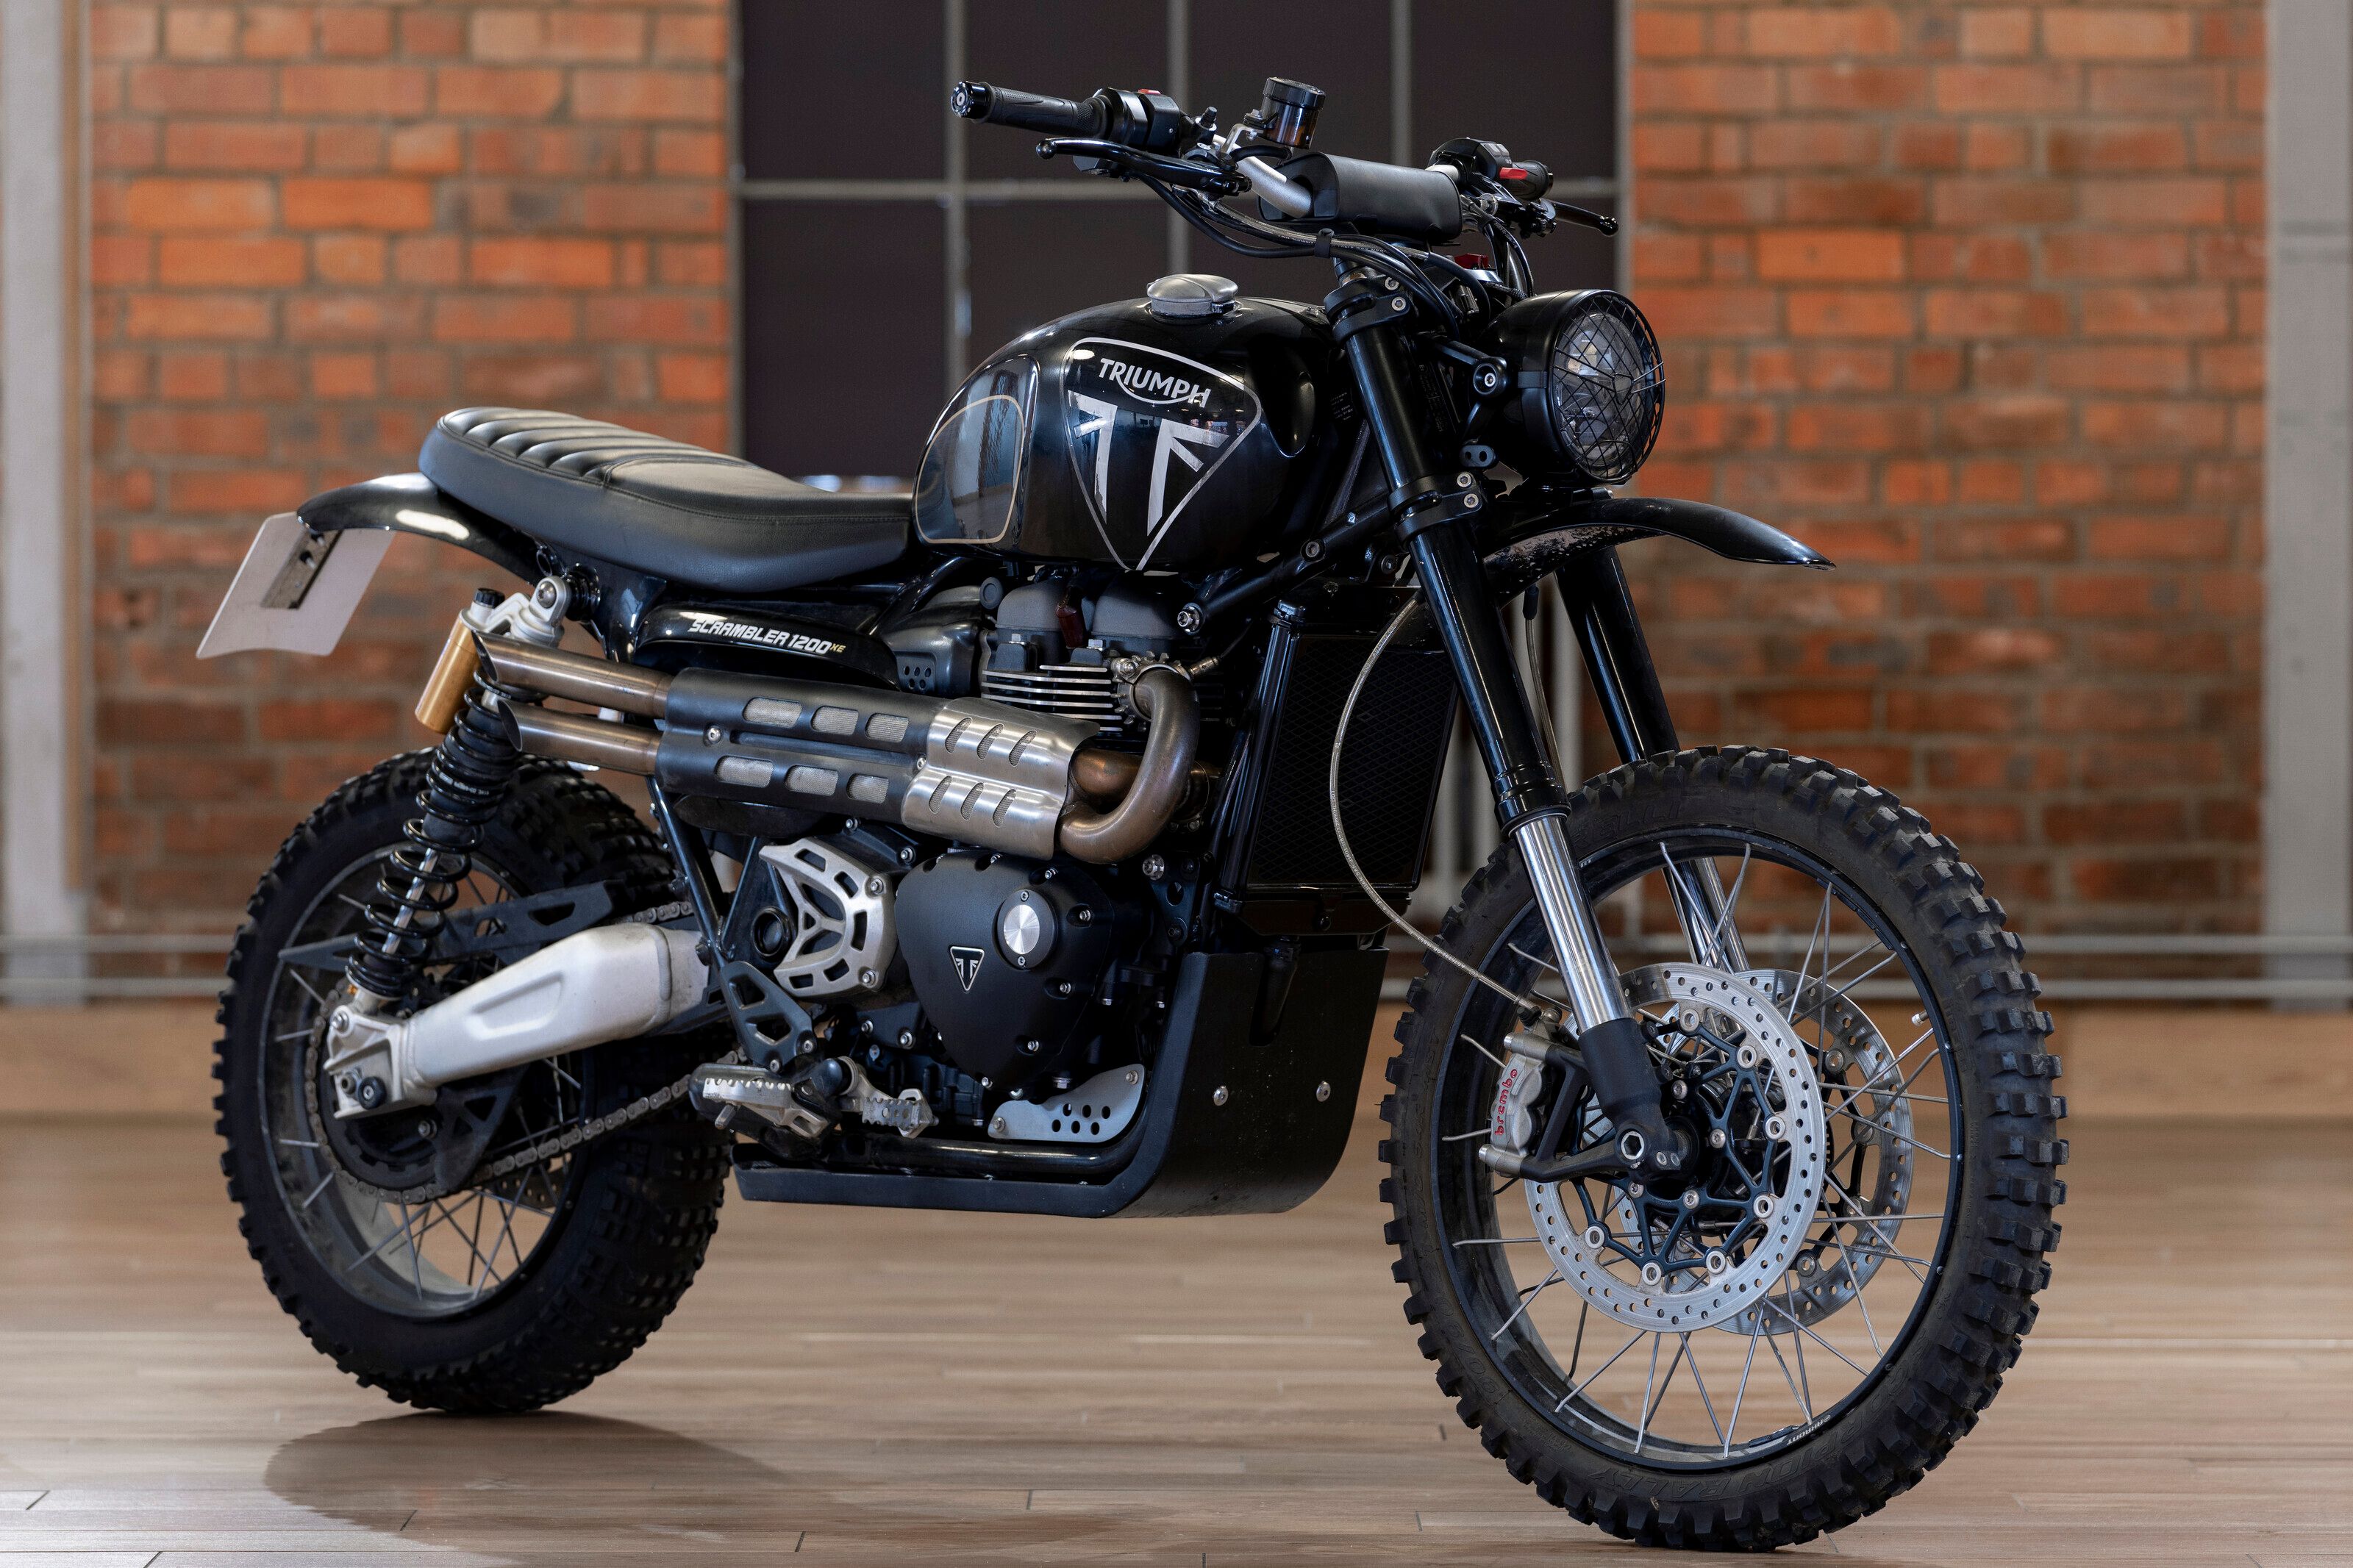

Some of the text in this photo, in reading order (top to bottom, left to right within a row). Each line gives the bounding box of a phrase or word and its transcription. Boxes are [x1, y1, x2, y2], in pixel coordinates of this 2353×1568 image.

[1099, 358, 1211, 408] TRIUMPH
[688, 619, 846, 654] SCRAMBLER 1200 XE
[1494, 1068, 1518, 1136] brembo
[1586, 1458, 1733, 1500] RALLY
